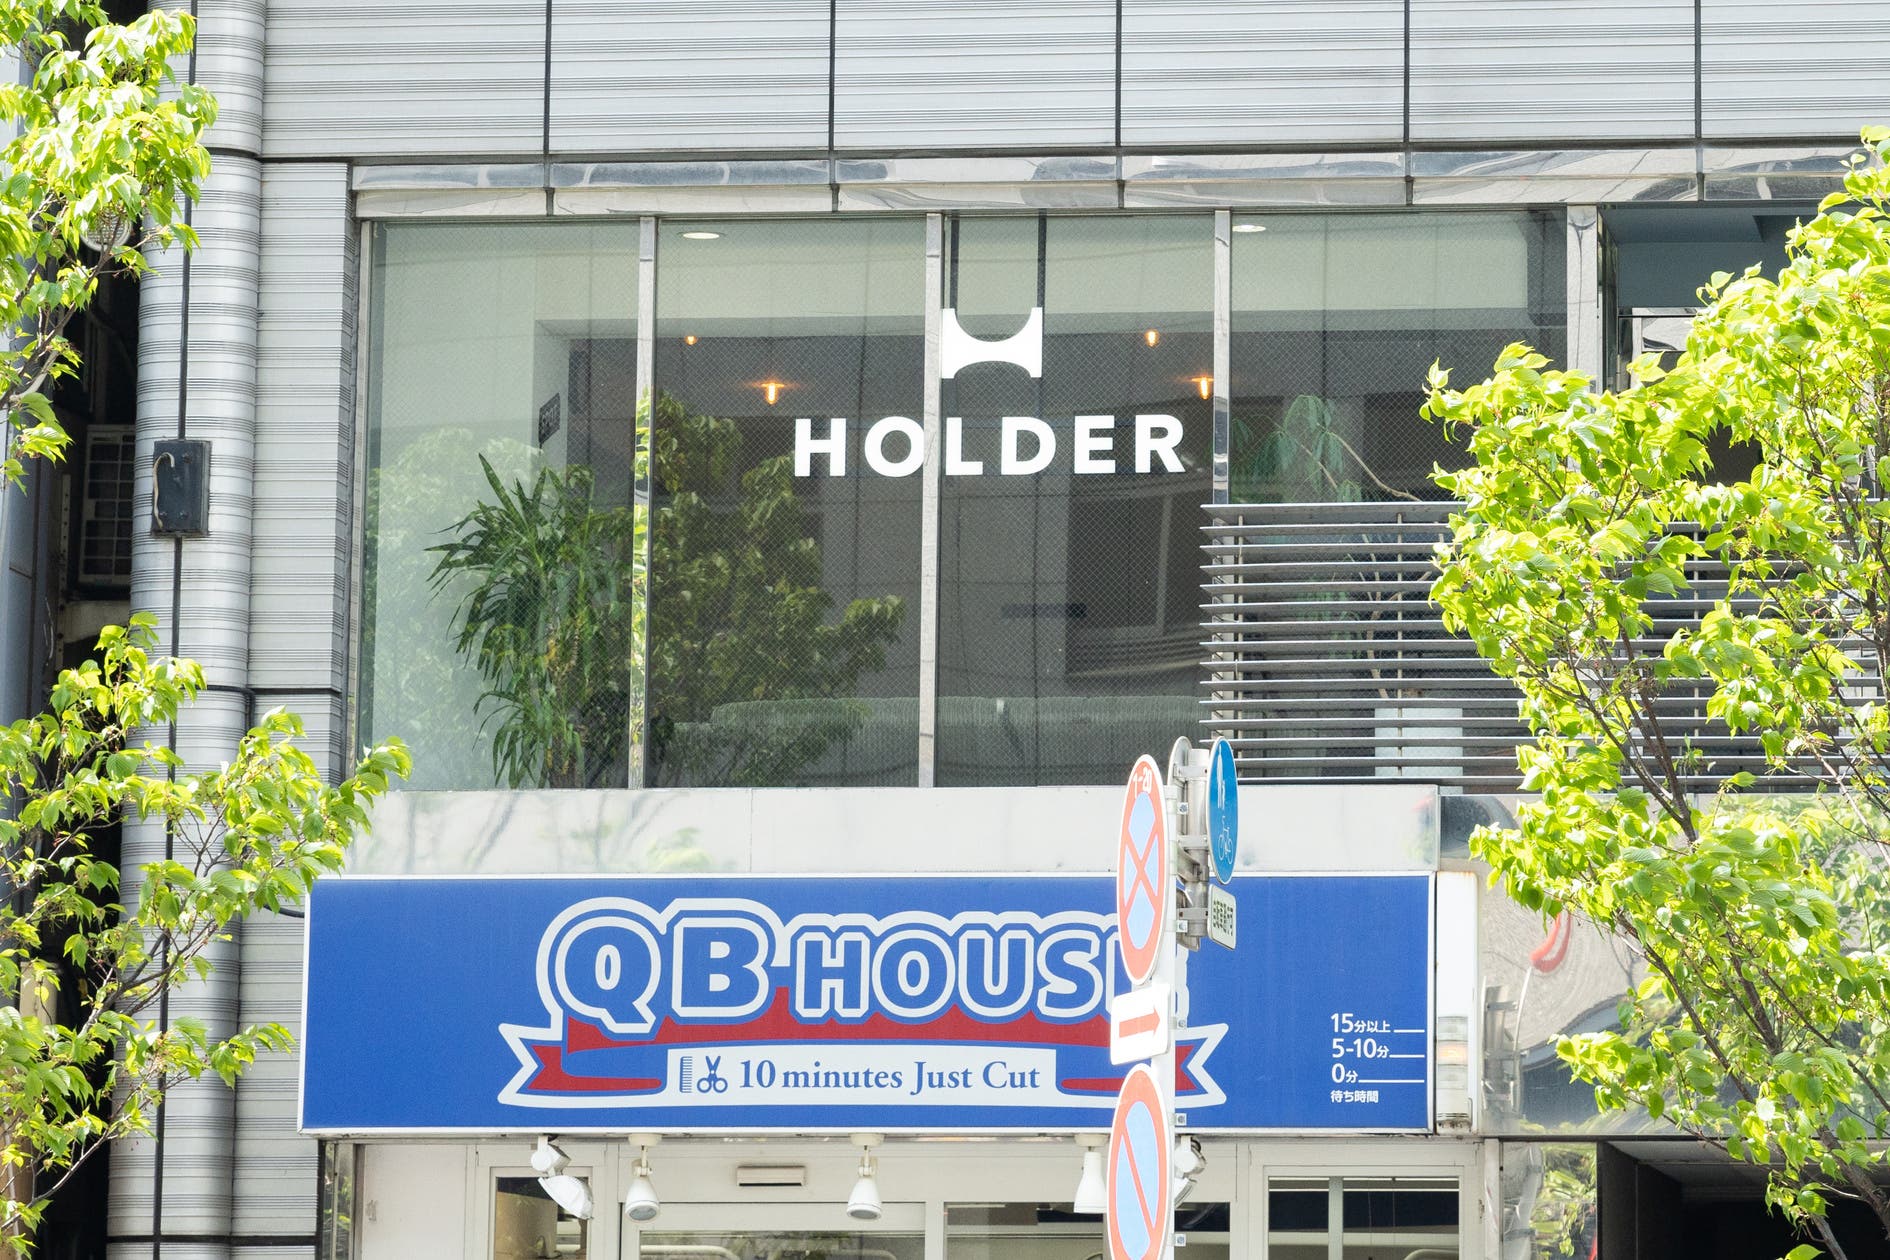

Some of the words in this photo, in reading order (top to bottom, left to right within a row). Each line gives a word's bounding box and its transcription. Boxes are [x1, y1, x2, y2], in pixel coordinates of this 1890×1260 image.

[794, 414, 1186, 477] HOLDER
[555, 916, 769, 1033] QB
[1330, 1013, 1391, 1033] 15分以上
[1332, 1038, 1390, 1059] 5-10分
[740, 1060, 776, 1088] 10
[782, 1061, 903, 1089] minutes
[910, 1061, 972, 1096] Just
[982, 1061, 1040, 1089] Cut
[1331, 1063, 1359, 1084] 0分
[1330, 1090, 1379, 1103] 待ち時間
